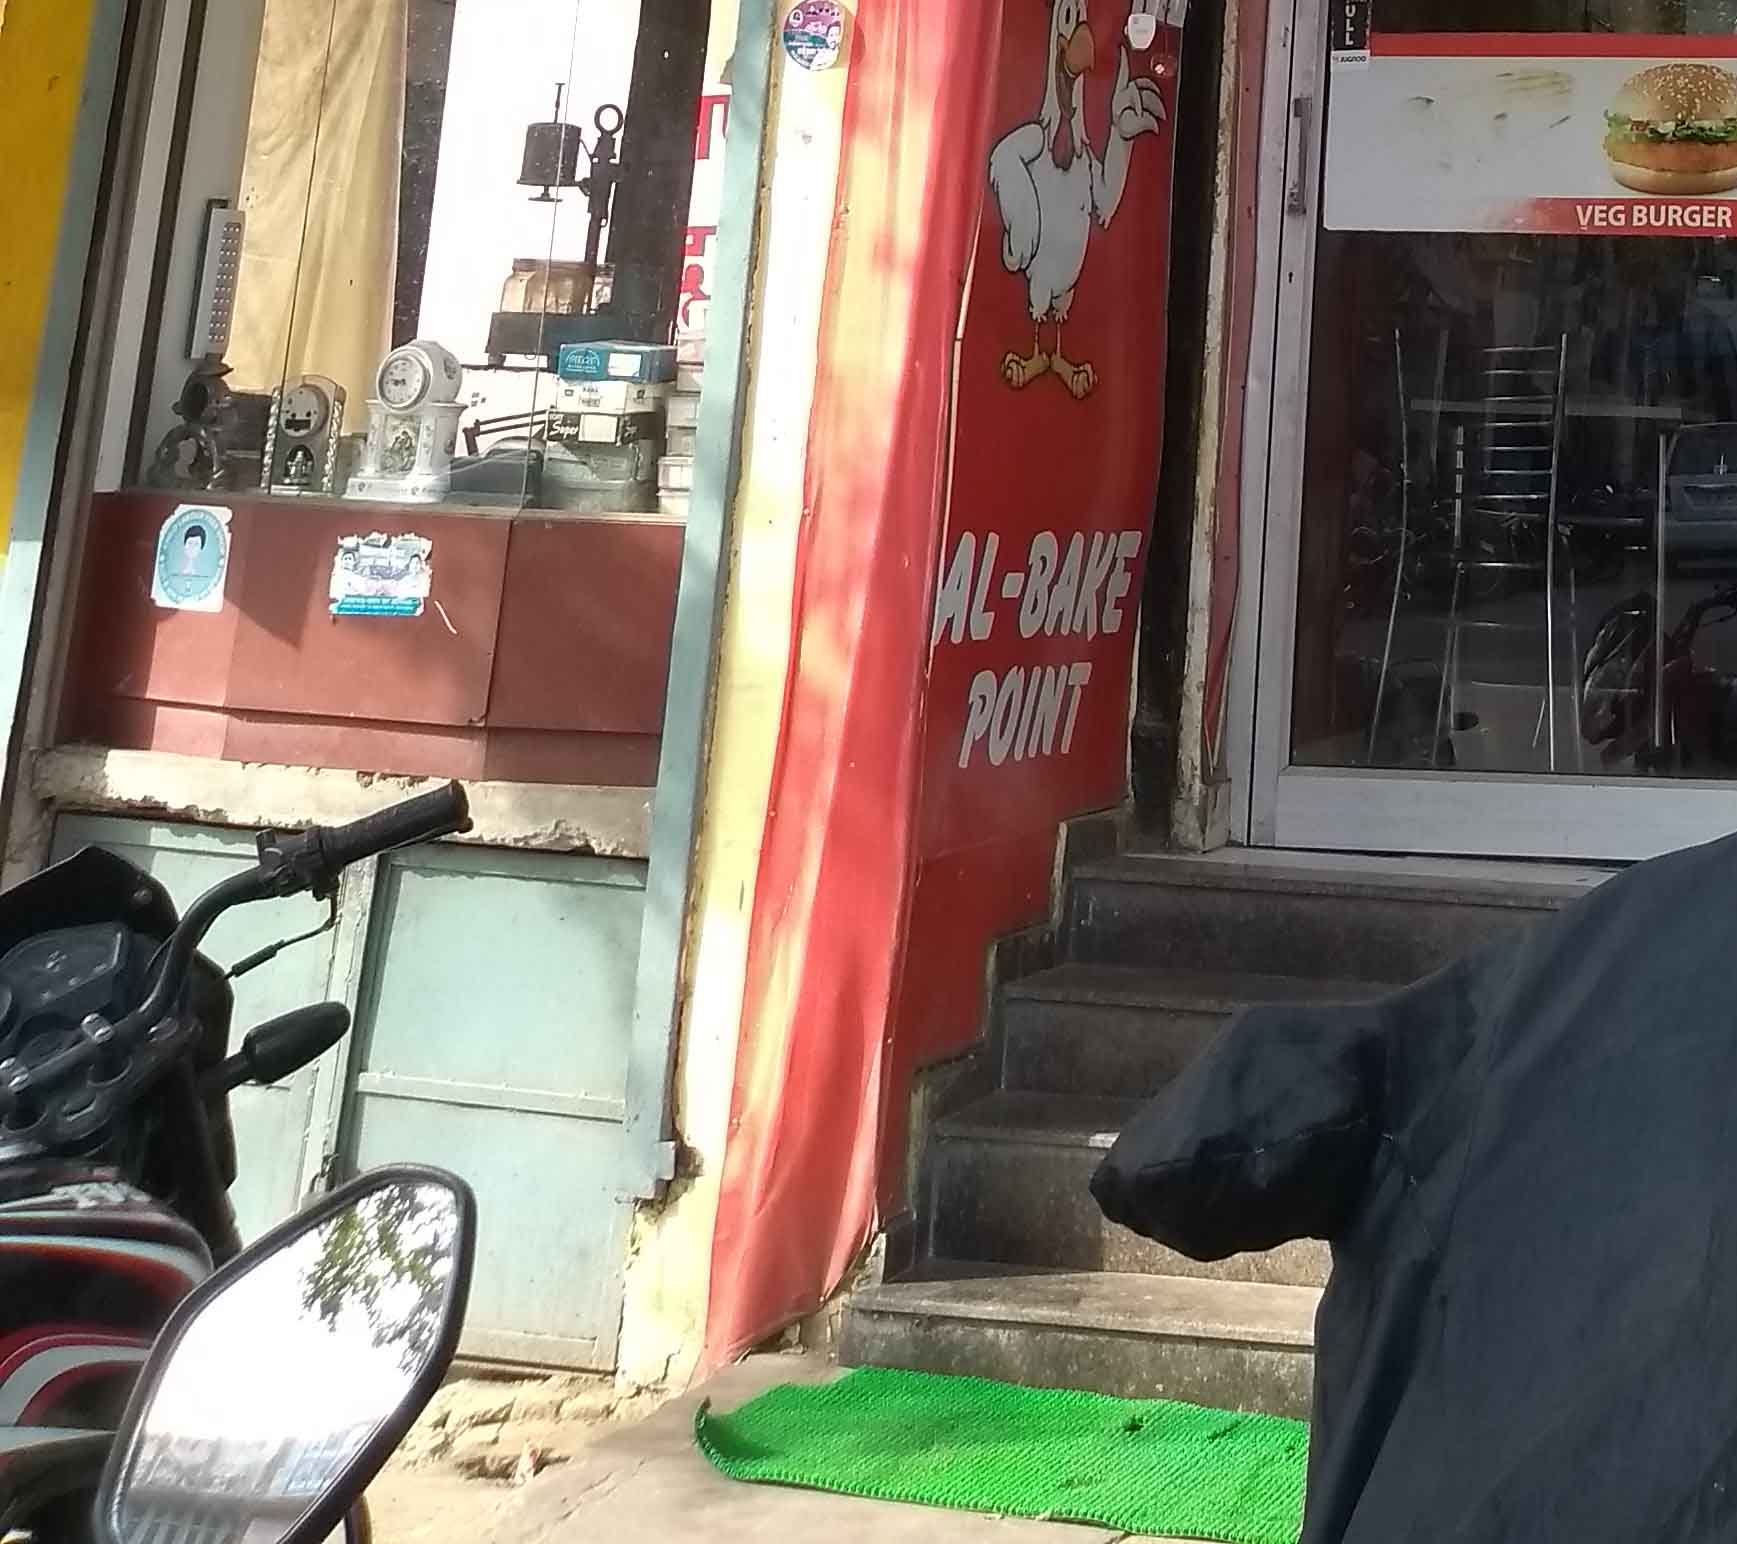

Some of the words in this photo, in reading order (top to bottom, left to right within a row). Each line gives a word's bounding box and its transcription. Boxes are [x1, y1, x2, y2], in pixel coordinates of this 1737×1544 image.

[1344, 0, 1357, 46] ULL
[1576, 205, 1624, 229] VEG
[1632, 205, 1733, 230] BURGER
[932, 530, 1143, 647] AL-BAKE
[957, 662, 1093, 769] POINT
